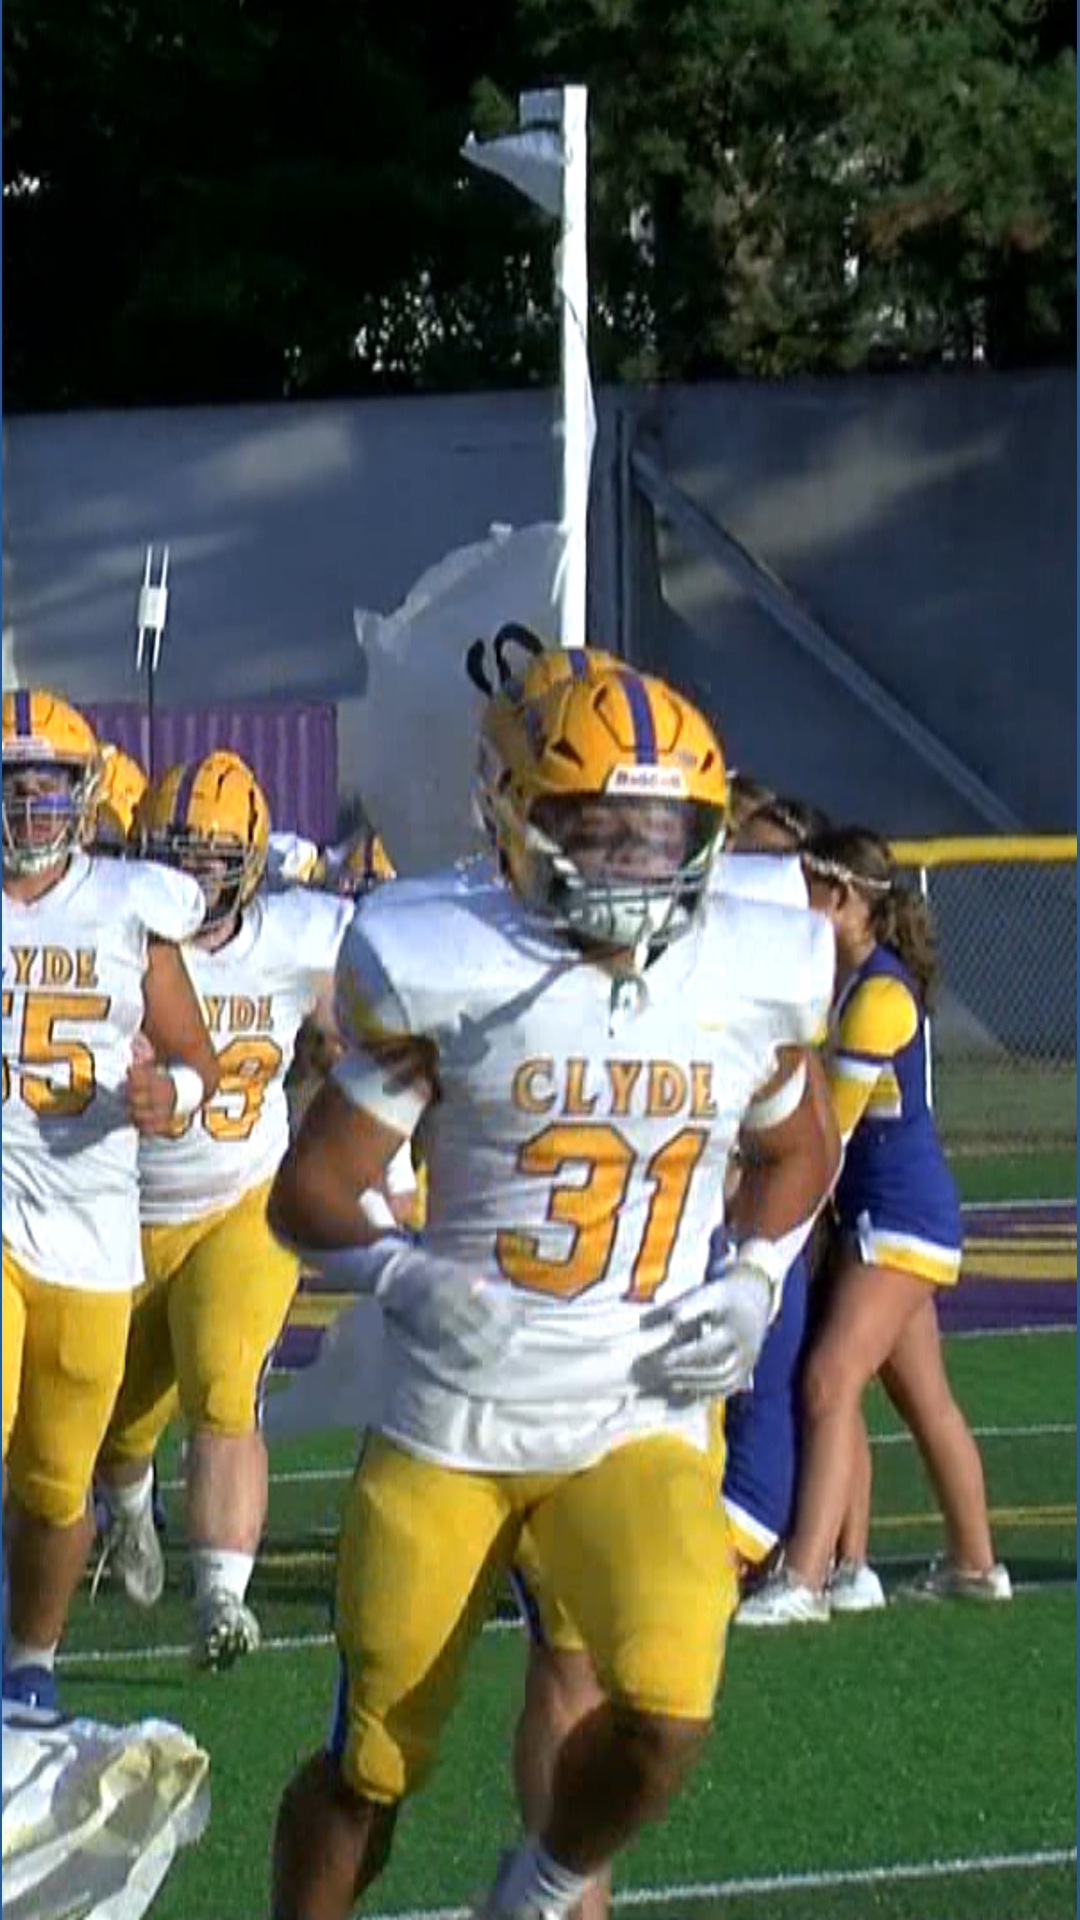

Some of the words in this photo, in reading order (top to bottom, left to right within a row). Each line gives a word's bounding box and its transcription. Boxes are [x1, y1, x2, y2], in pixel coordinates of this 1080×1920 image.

[2, 988, 112, 1117] 5
[512, 1057, 718, 1119] CLYDE
[495, 1122, 711, 1303] 31
